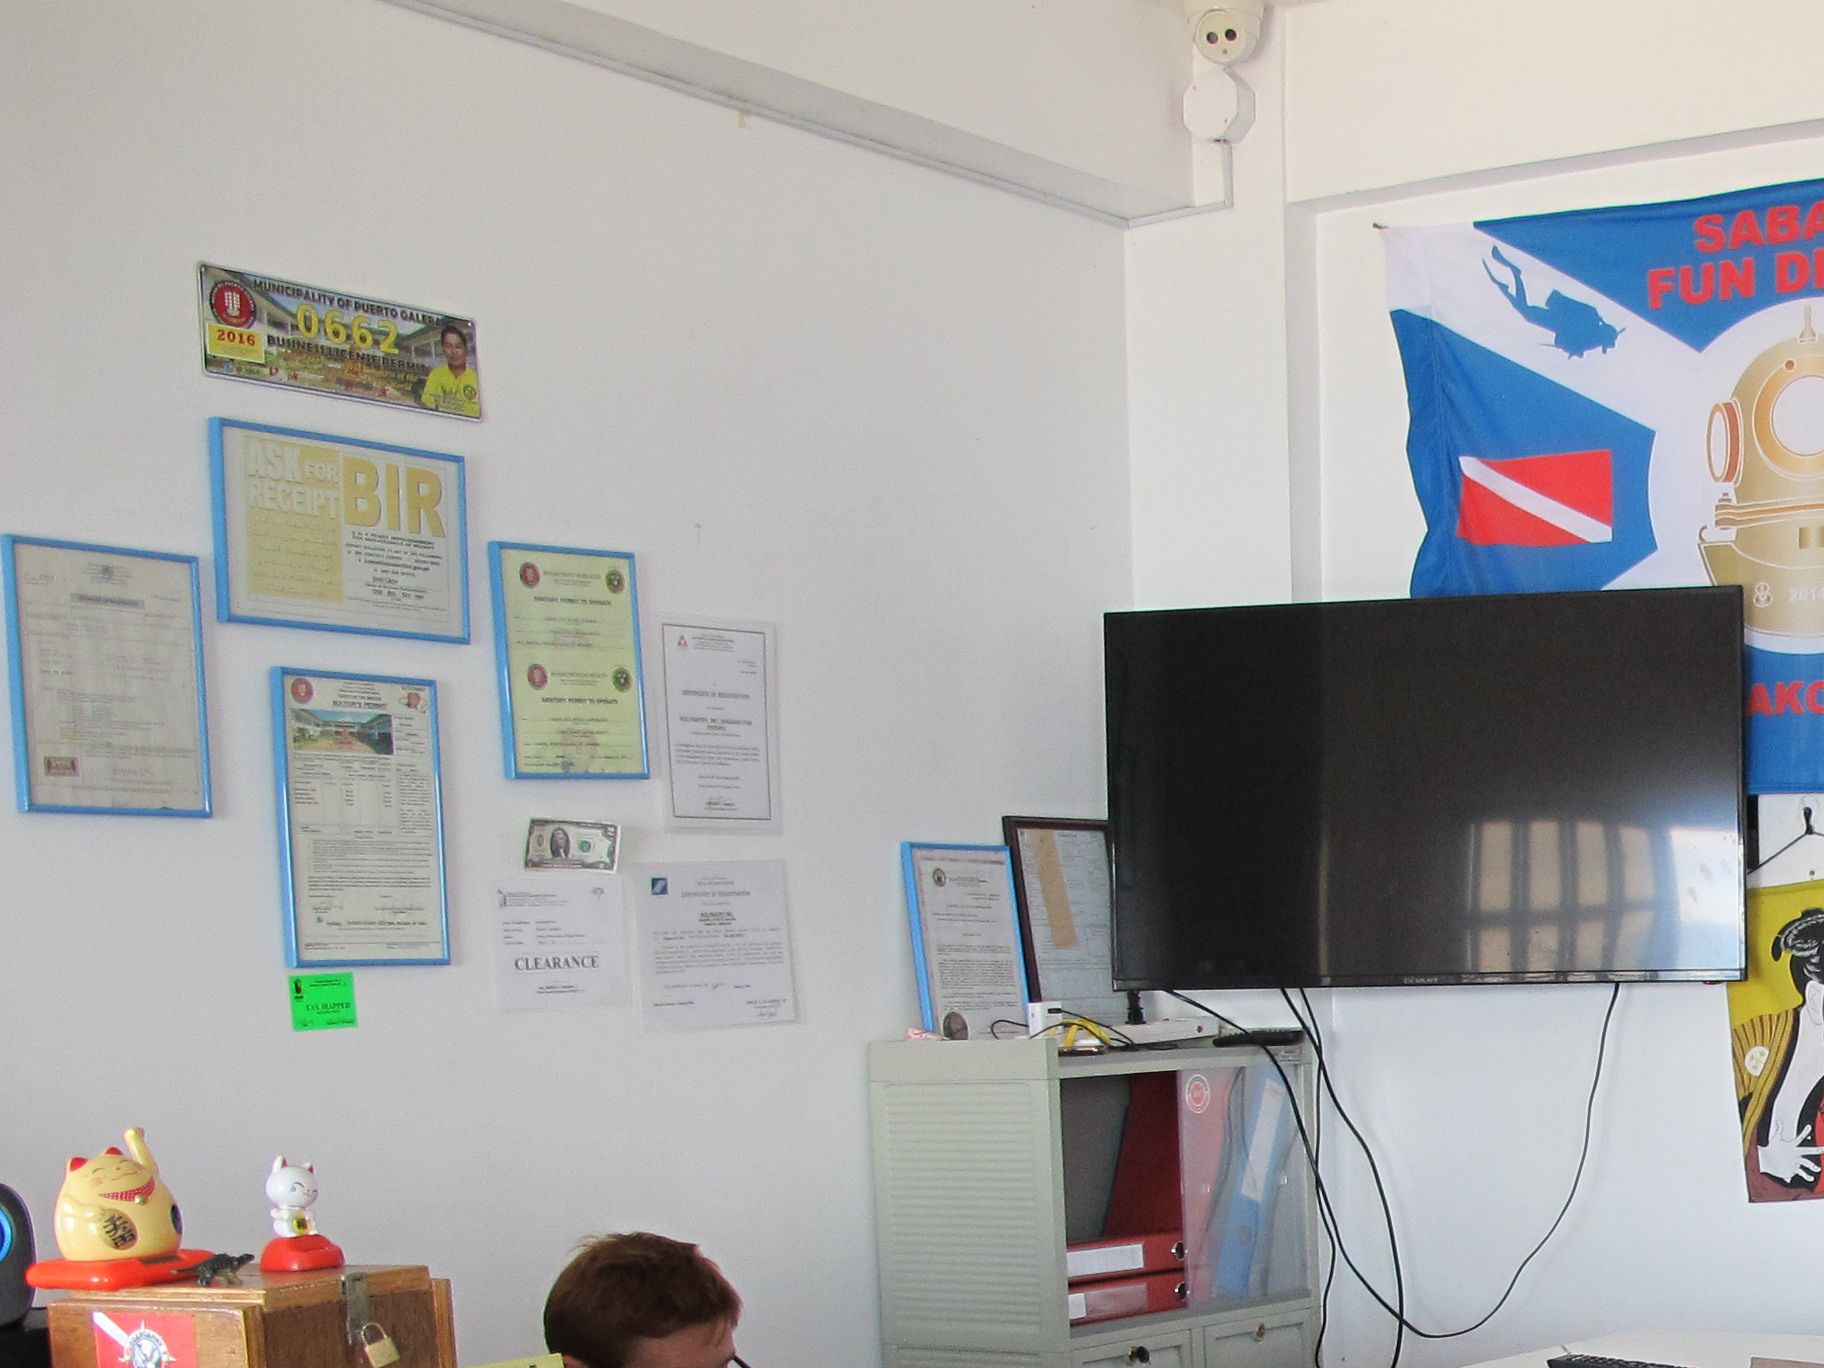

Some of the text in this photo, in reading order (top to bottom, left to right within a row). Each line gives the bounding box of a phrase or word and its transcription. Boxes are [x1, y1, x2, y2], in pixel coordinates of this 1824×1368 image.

[252, 278, 441, 326] MUNICIPALITY OF PUERTO GALERA
[1648, 258, 1755, 310] FUN
[217, 329, 256, 346] 2016
[267, 335, 325, 356] BUSINESS
[327, 346, 380, 365] LICENSE
[297, 304, 399, 354] 0662
[249, 440, 339, 483] ASK FOR
[249, 482, 338, 519] RECEIPT
[344, 456, 446, 538] BIR
[514, 955, 600, 971] CLEARANCE
